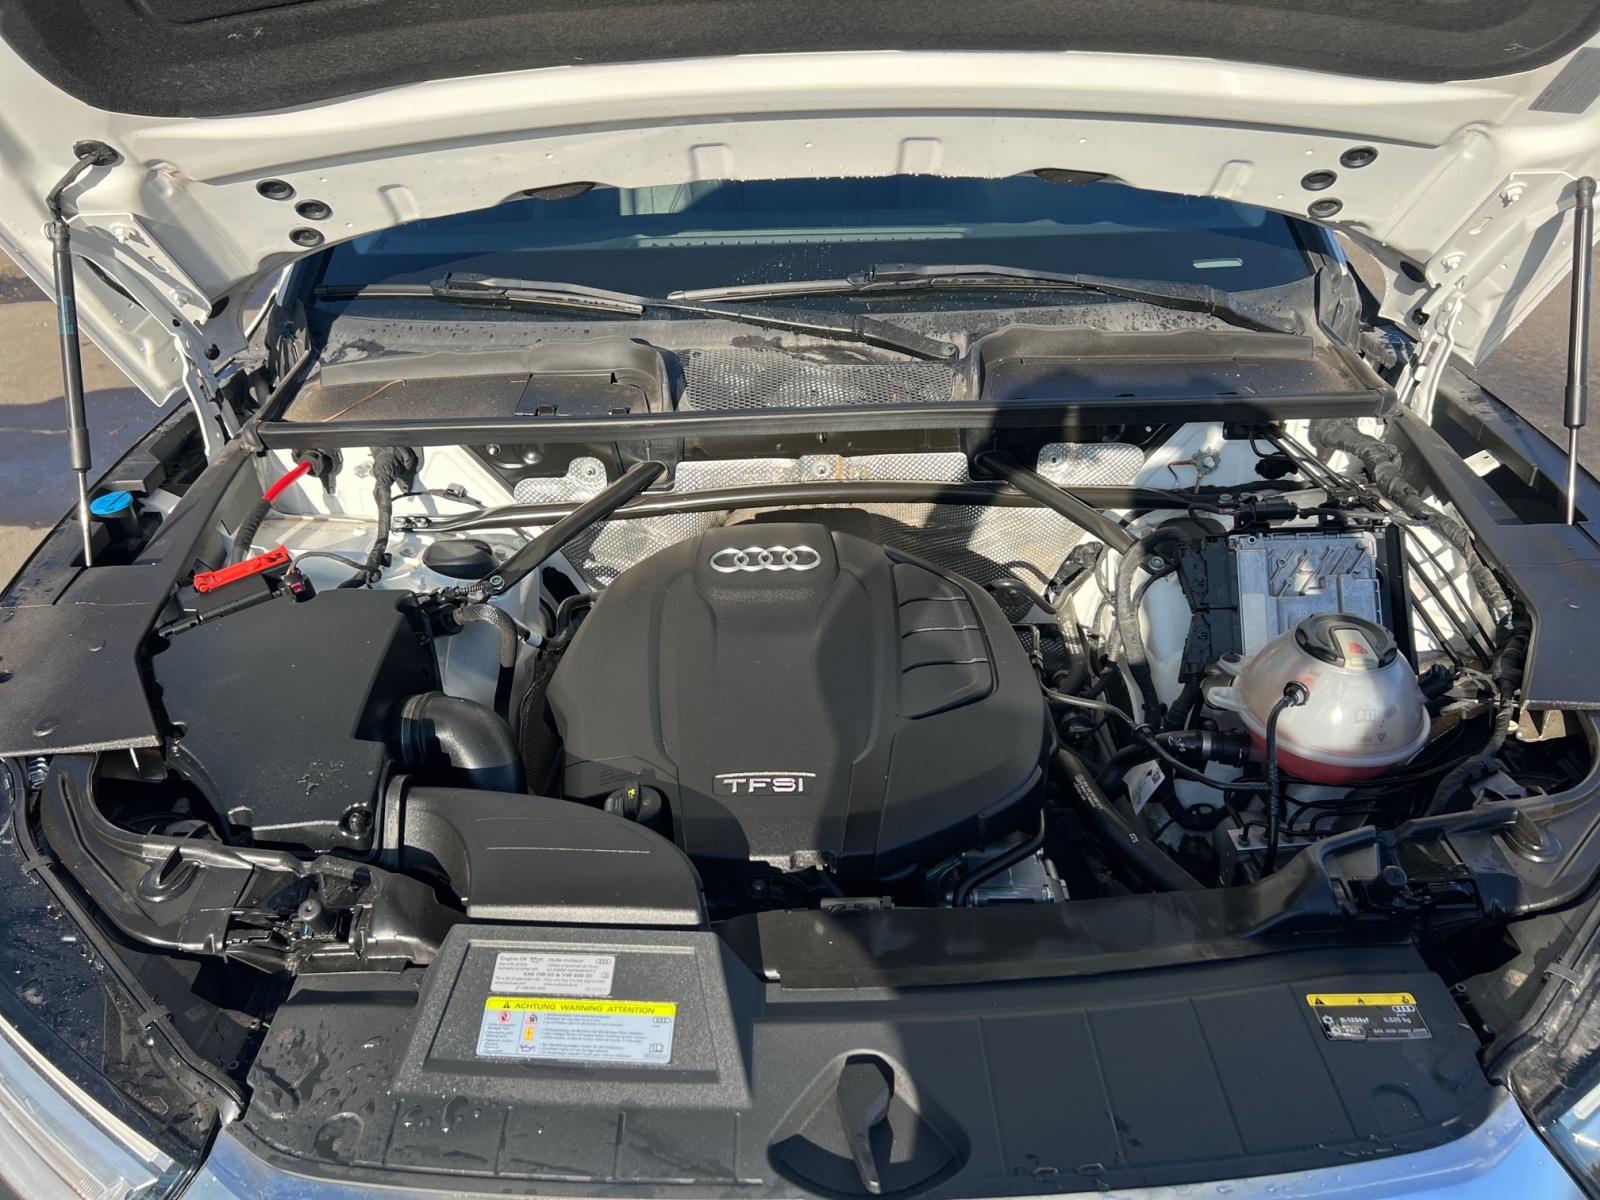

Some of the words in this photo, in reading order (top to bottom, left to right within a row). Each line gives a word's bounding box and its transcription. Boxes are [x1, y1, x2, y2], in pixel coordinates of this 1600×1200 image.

[723, 777, 804, 793] TFSI
[514, 1002, 556, 1010] ACHTUNG
[560, 1004, 603, 1012] WARNING
[607, 1006, 655, 1014] ATTENTION
